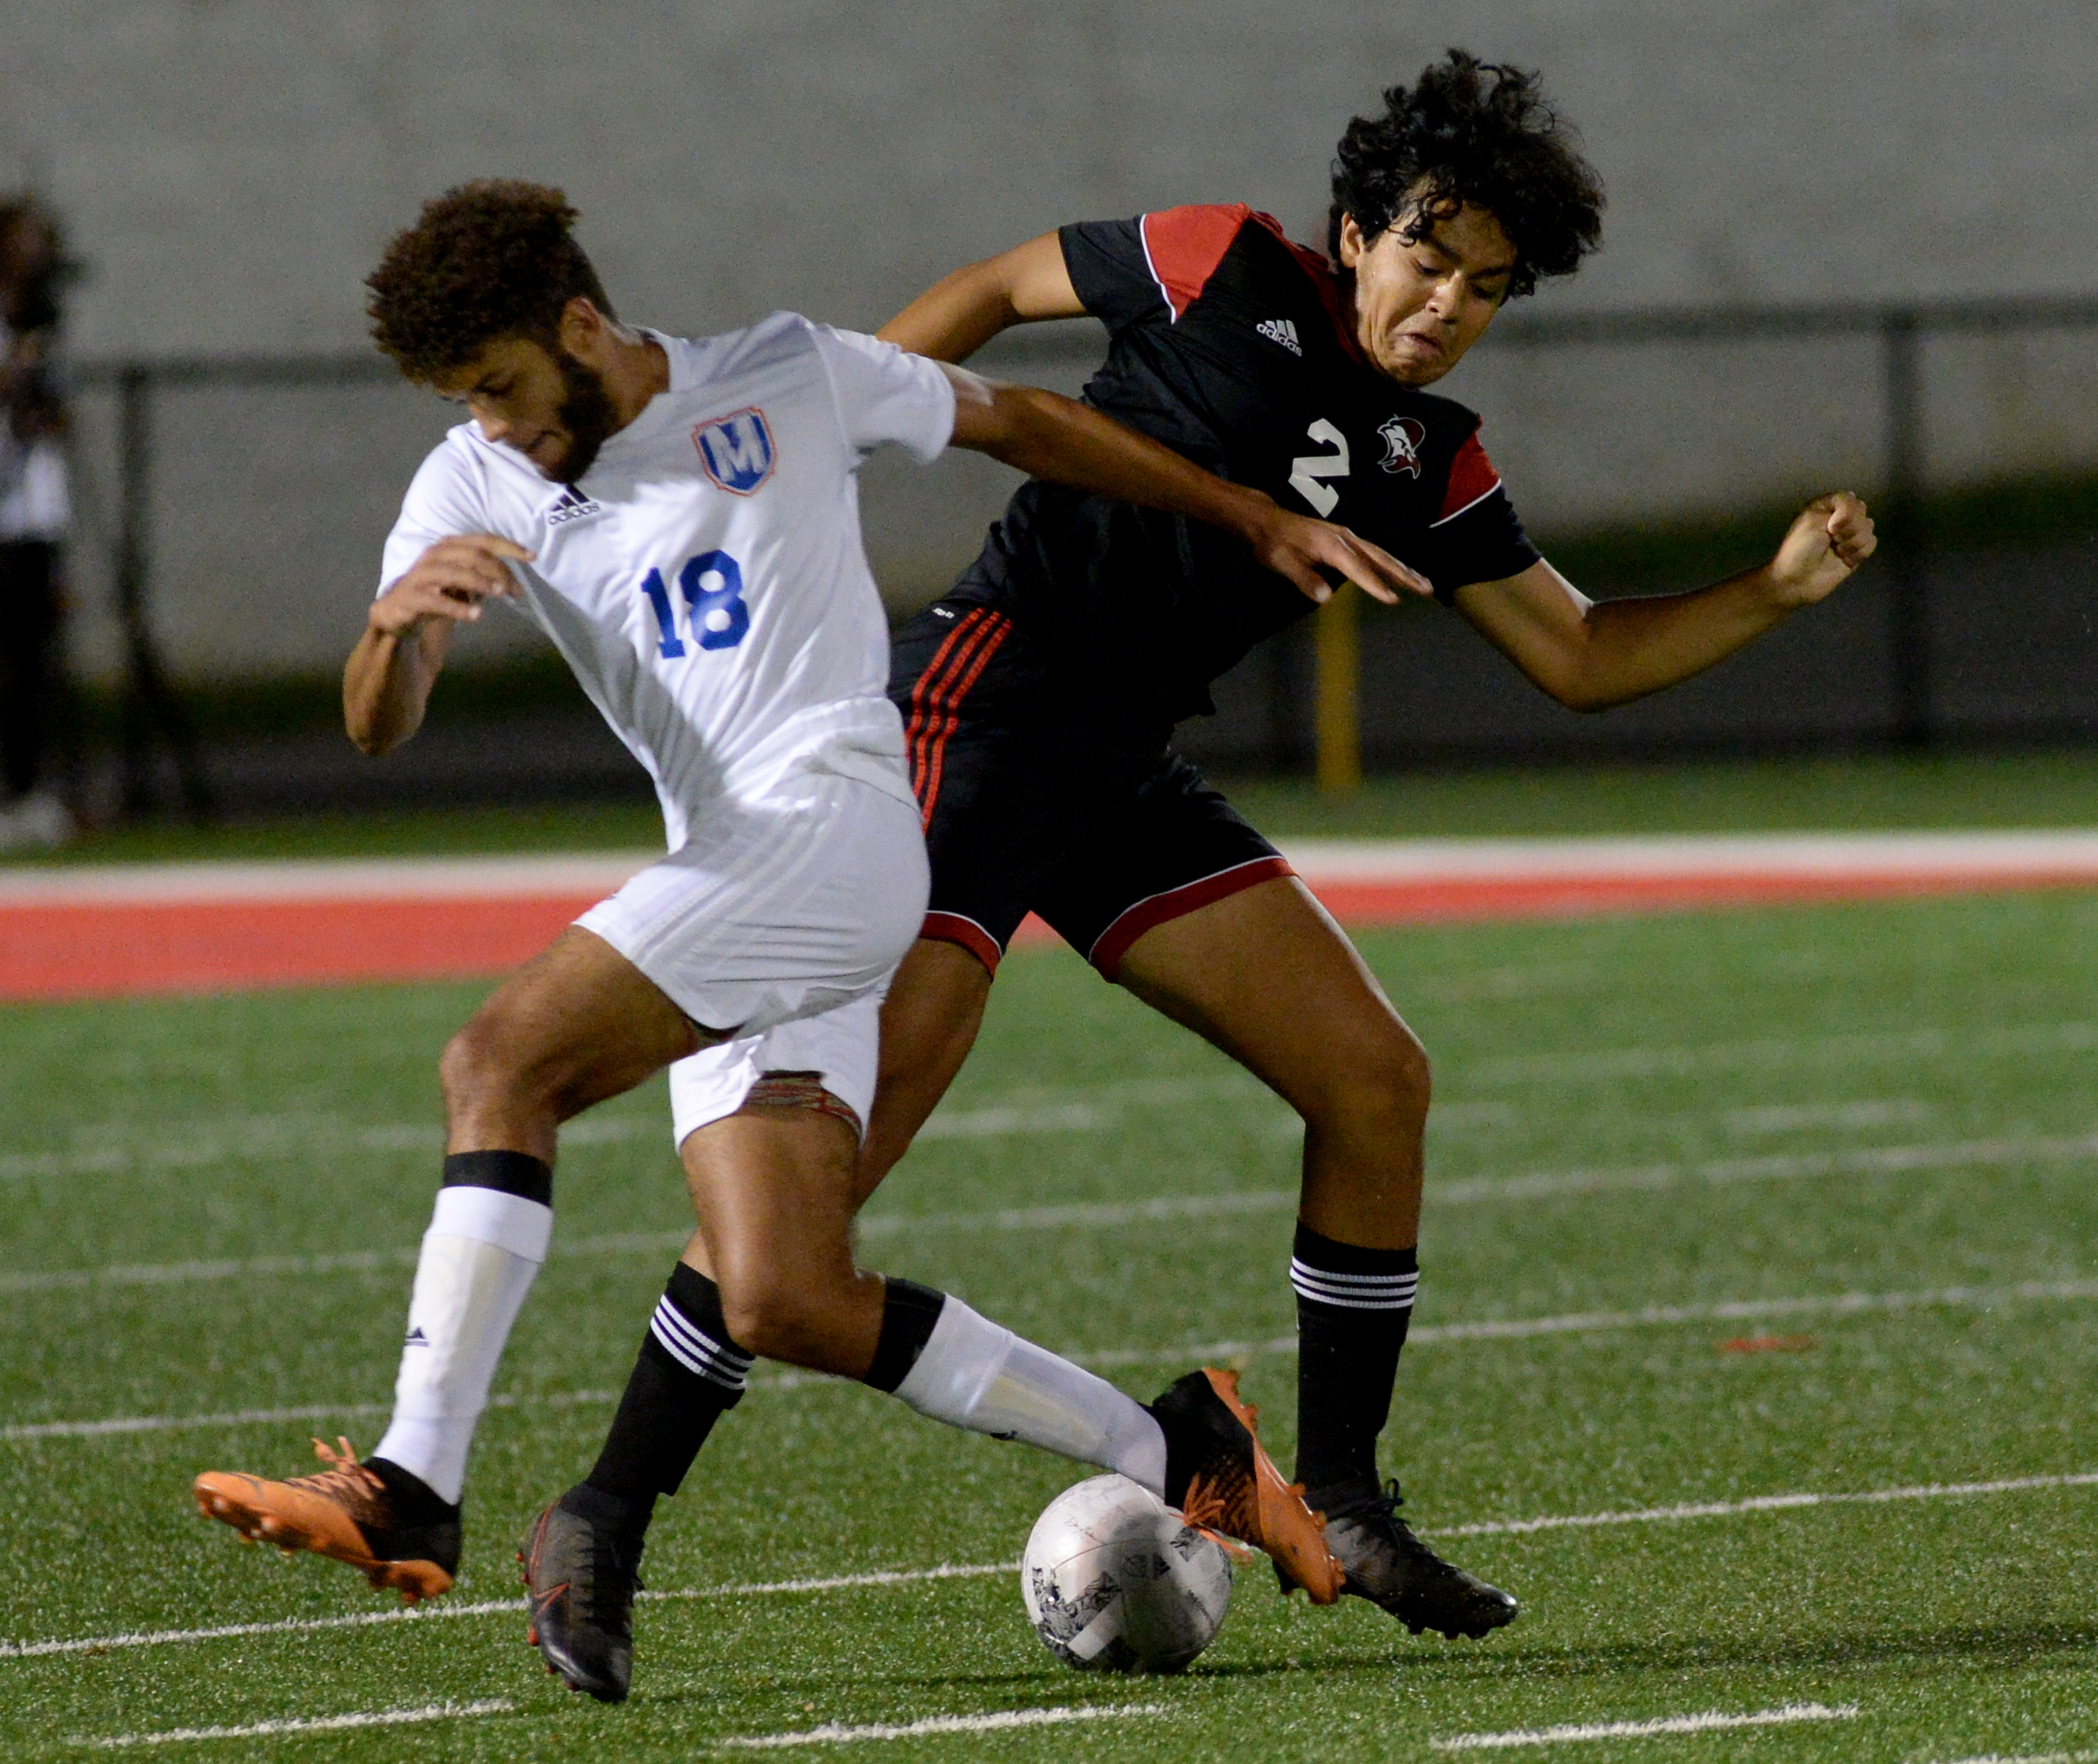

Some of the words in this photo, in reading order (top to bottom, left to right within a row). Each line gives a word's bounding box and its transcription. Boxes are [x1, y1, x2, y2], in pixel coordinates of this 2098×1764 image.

[1256, 323, 1303, 357] adidas
[701, 412, 767, 484] M
[1288, 418, 1350, 518] 2
[549, 502, 601, 526] adidas
[640, 549, 750, 659] 18
